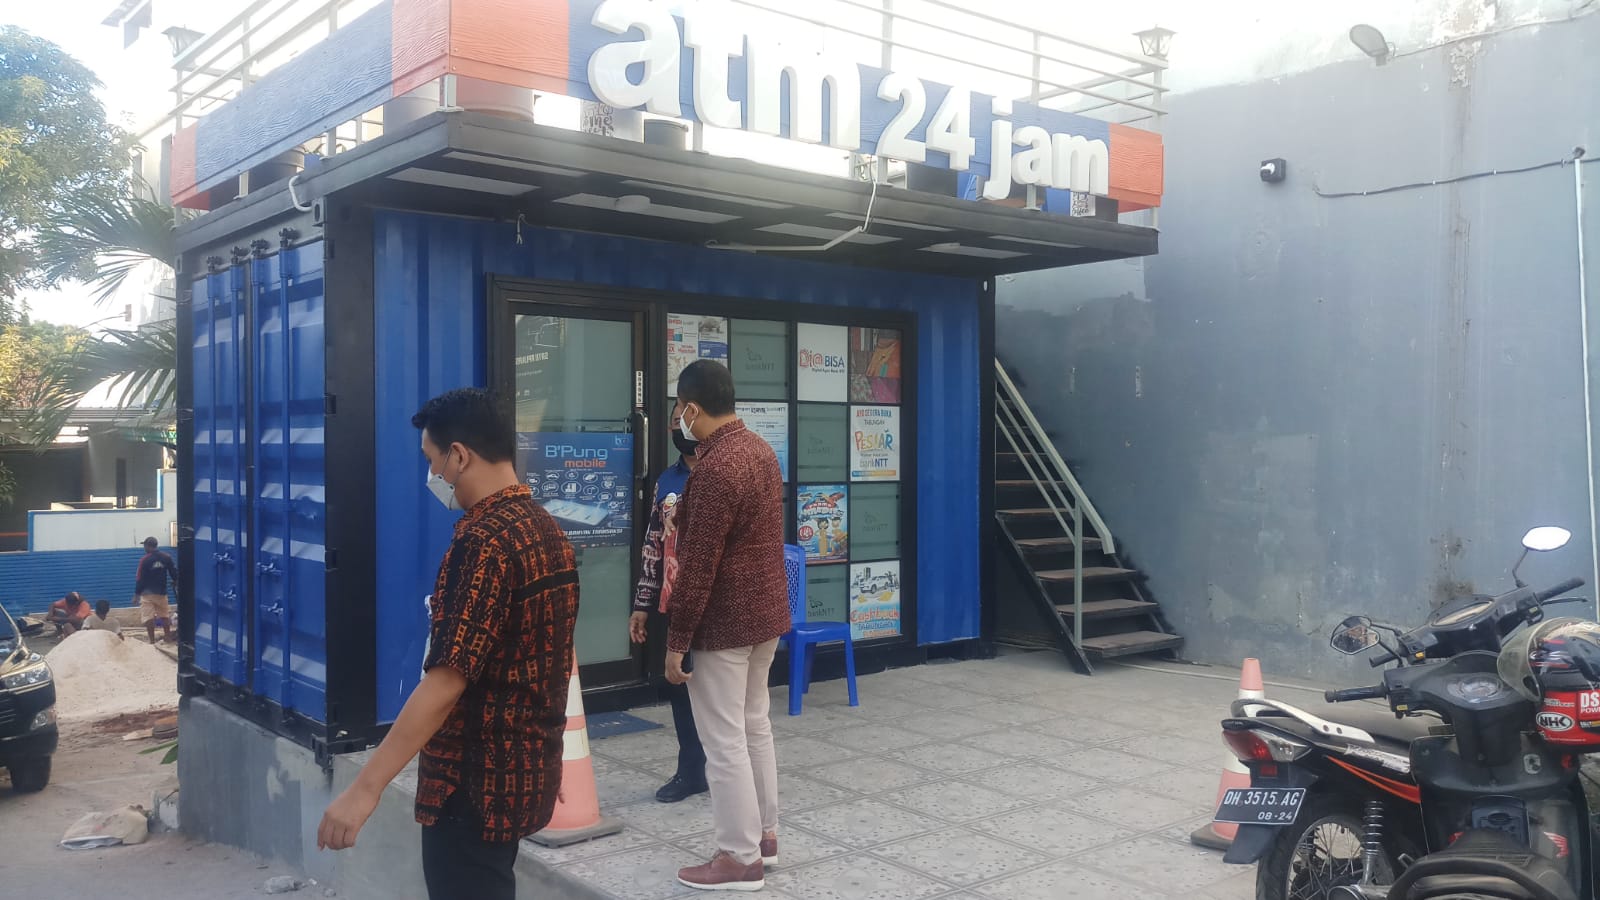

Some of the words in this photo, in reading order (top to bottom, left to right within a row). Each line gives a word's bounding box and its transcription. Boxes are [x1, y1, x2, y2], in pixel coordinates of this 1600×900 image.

[587, 0, 861, 151] atm
[875, 71, 976, 170] 24
[983, 96, 1110, 200] jam
[824, 355, 845, 367] BISA
[545, 444, 608, 460] B'Pung
[564, 459, 606, 468] mobile
[1539, 715, 1571, 728] NHK
[1224, 791, 1241, 805] DH
[1280, 791, 1300, 806] AG
